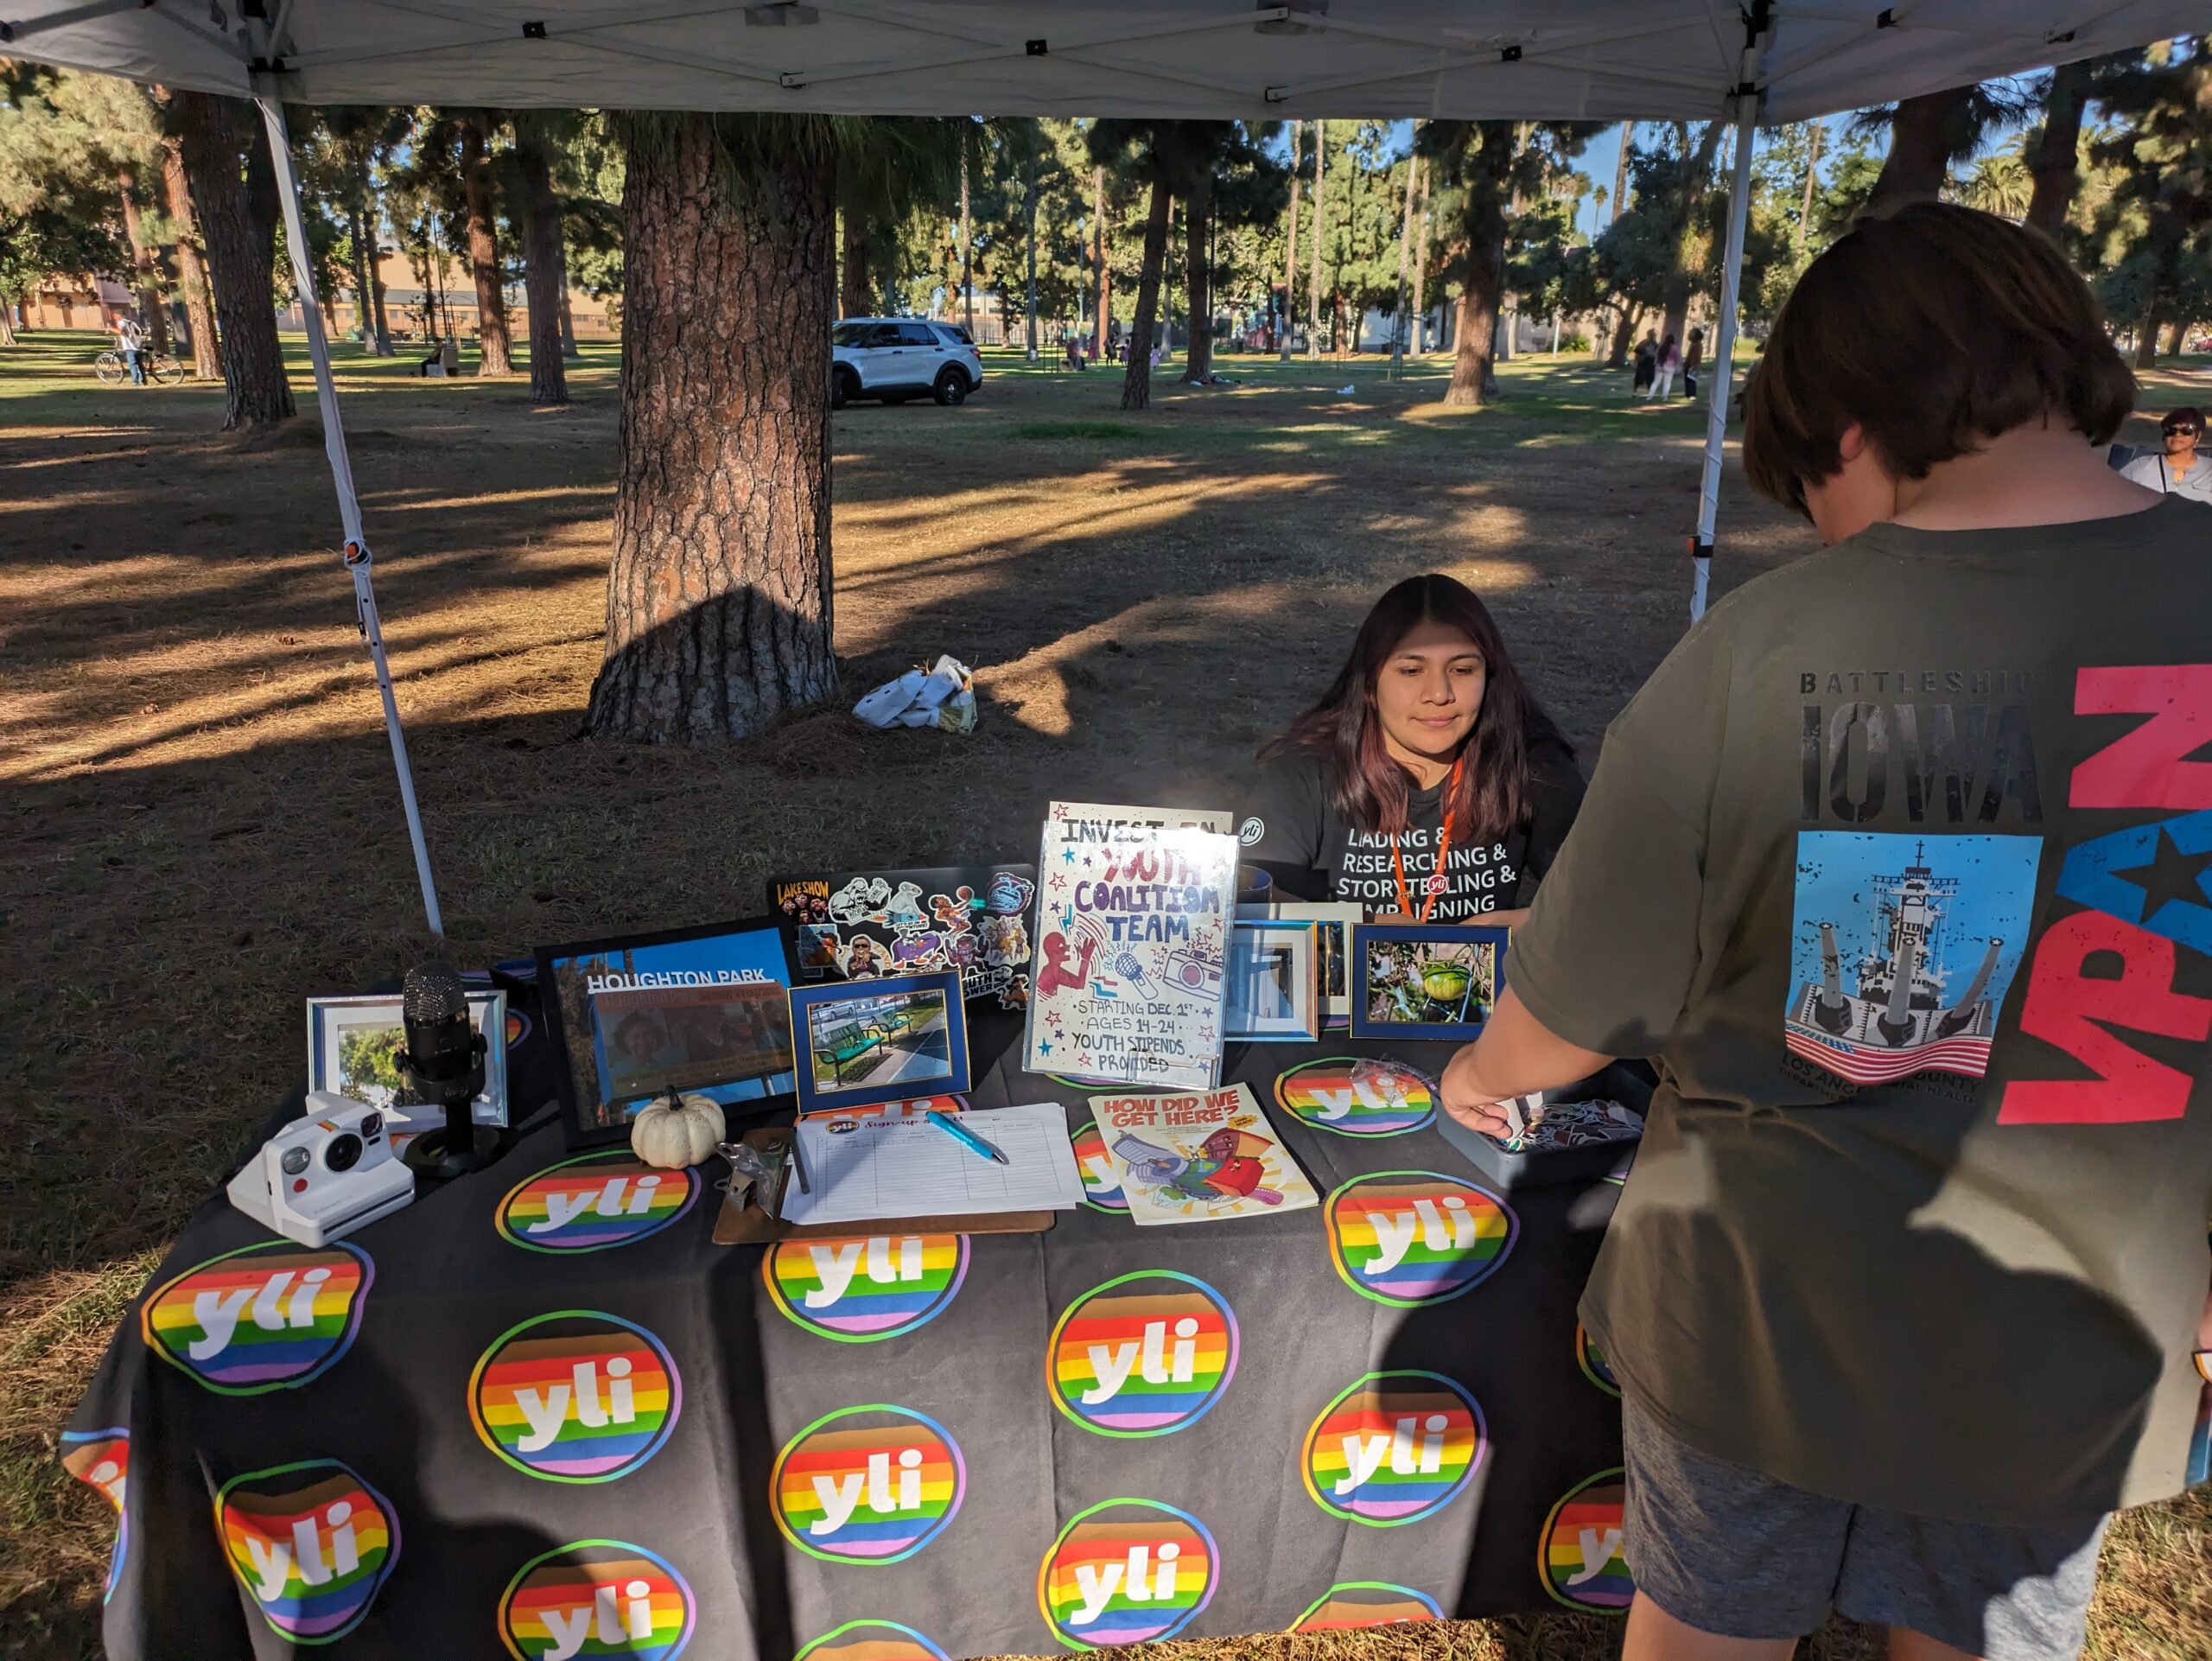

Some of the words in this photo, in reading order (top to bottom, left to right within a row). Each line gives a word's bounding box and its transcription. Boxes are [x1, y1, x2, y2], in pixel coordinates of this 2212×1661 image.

[1800, 670, 2034, 694] BATTLESHIP
[1800, 701, 2044, 824] IOWA
[1061, 818, 1165, 843] INVEST
[1241, 824, 1260, 838] yli
[1348, 828, 1428, 849] LADING
[1101, 848, 1202, 886] YOUTH
[1343, 846, 1488, 874] RESEARCHING
[1493, 843, 1507, 862] &
[1336, 869, 1496, 898] STORYTELING
[1500, 864, 1516, 882] &
[1430, 878, 1445, 890] yli
[1074, 880, 1220, 914] COALITION
[1105, 914, 1190, 943] TEAM
[588, 971, 713, 990] HOUGHTON
[717, 968, 767, 983] PARK
[735, 985, 782, 1001] Programs
[963, 973, 992, 990] OUTH
[963, 983, 993, 997] OWER
[1078, 1000, 1144, 1015] STARTING
[1147, 1002, 1175, 1016] DEC.
[1087, 1017, 1132, 1030] AGES
[1136, 1018, 1175, 1034] 14-24
[1072, 1032, 1125, 1052] YOUTH
[1128, 1036, 1185, 1055] STIPENDS
[1099, 1054, 1170, 1072] PROVIDED
[1103, 1098, 1157, 1114] HOW
[1161, 1097, 1199, 1112] DID
[1203, 1089, 1241, 1108] WE
[1307, 1072, 1409, 1121] yli
[833, 1123, 853, 1132] yli
[865, 1118, 918, 1129] Sign-up
[1111, 1112, 1159, 1128] GET
[1165, 1104, 1239, 1125] HERE?
[526, 1175, 662, 1233] yli
[1364, 1196, 1477, 1276] yli
[804, 1236, 923, 1309] yli
[188, 1267, 332, 1361] yli
[1081, 1317, 1199, 1405] yli
[513, 1357, 637, 1453] yli
[1335, 1414, 1451, 1496] yli
[809, 1448, 924, 1536] yli
[244, 1500, 360, 1602] yli
[1069, 1542, 1181, 1626] yli
[539, 1580, 653, 1661] yli
